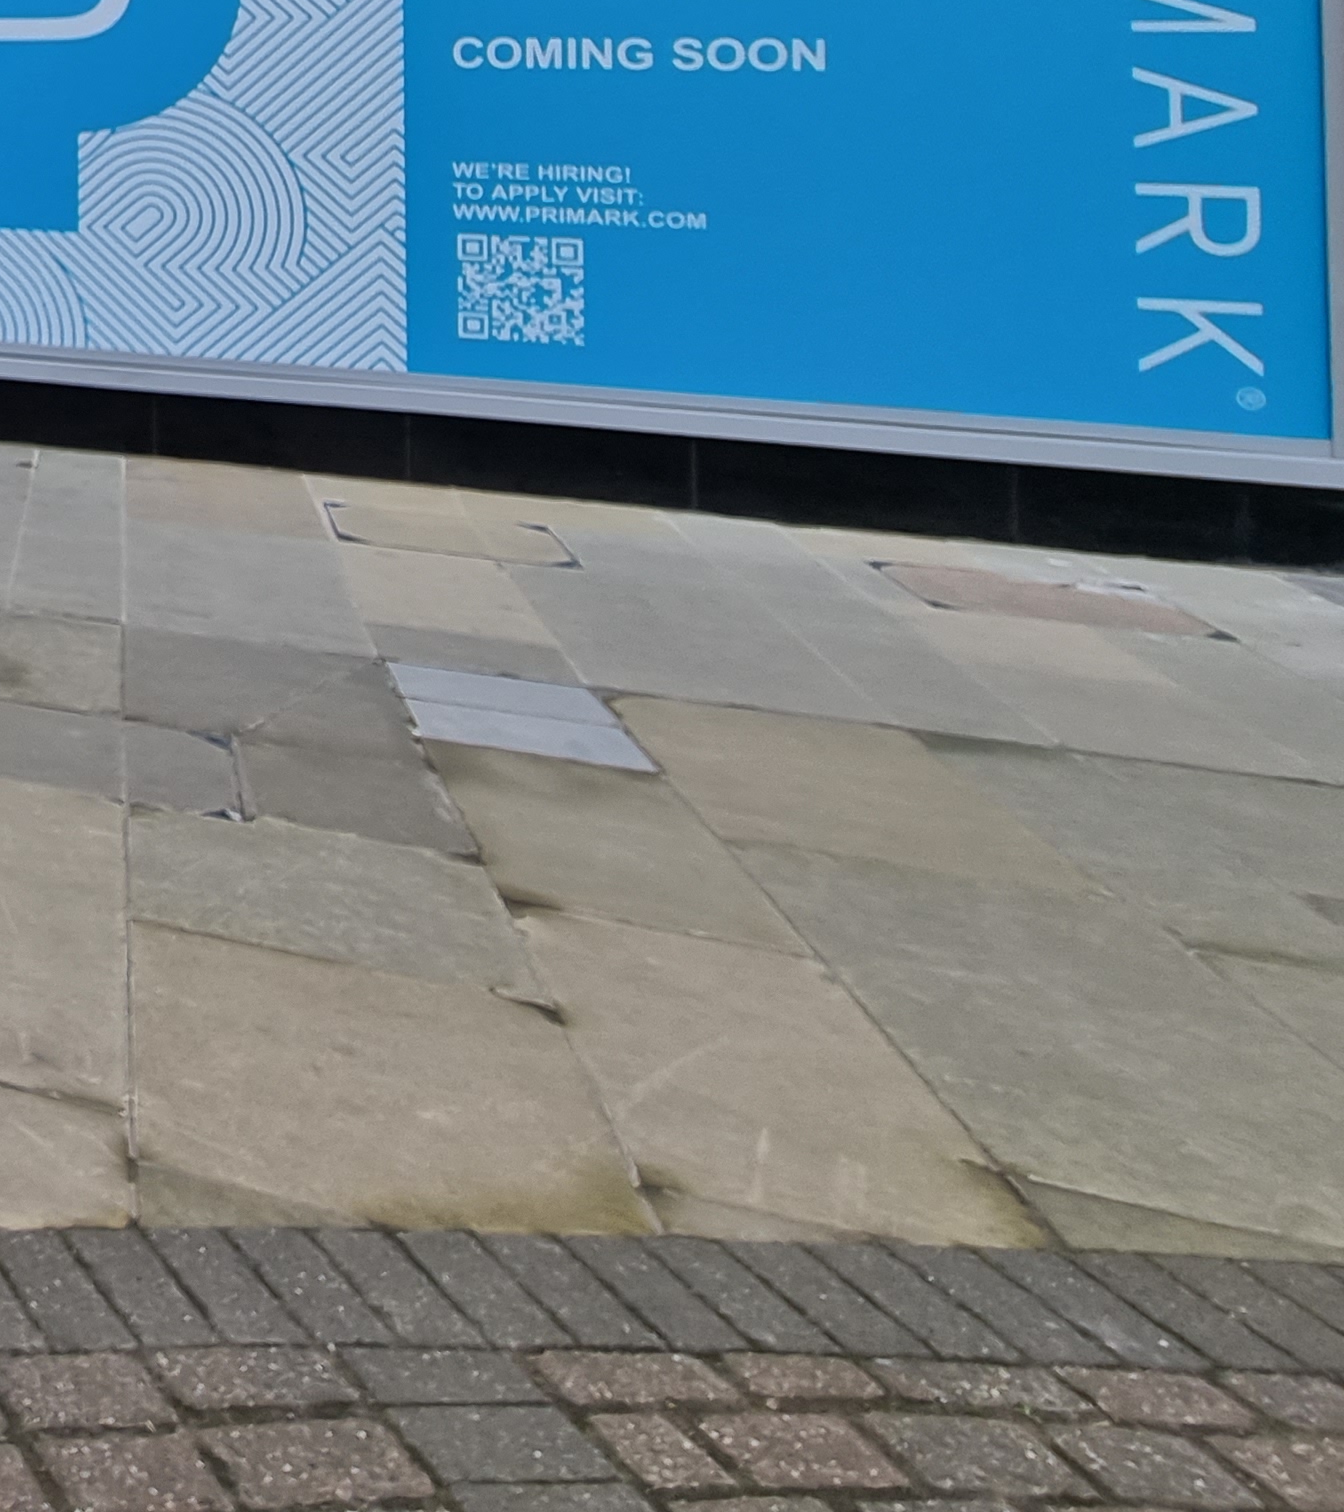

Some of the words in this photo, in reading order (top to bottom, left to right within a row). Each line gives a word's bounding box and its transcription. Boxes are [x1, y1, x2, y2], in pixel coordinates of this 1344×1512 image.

[452, 36, 654, 71] COMING
[672, 36, 827, 72] SOON
[452, 161, 530, 181] WE'RE
[537, 164, 632, 184] HIRING!
[452, 182, 484, 201] TO
[491, 184, 568, 203] APPLY
[575, 187, 645, 207] VISIT:
[452, 203, 708, 230] WWW.PRIMARK.COM
